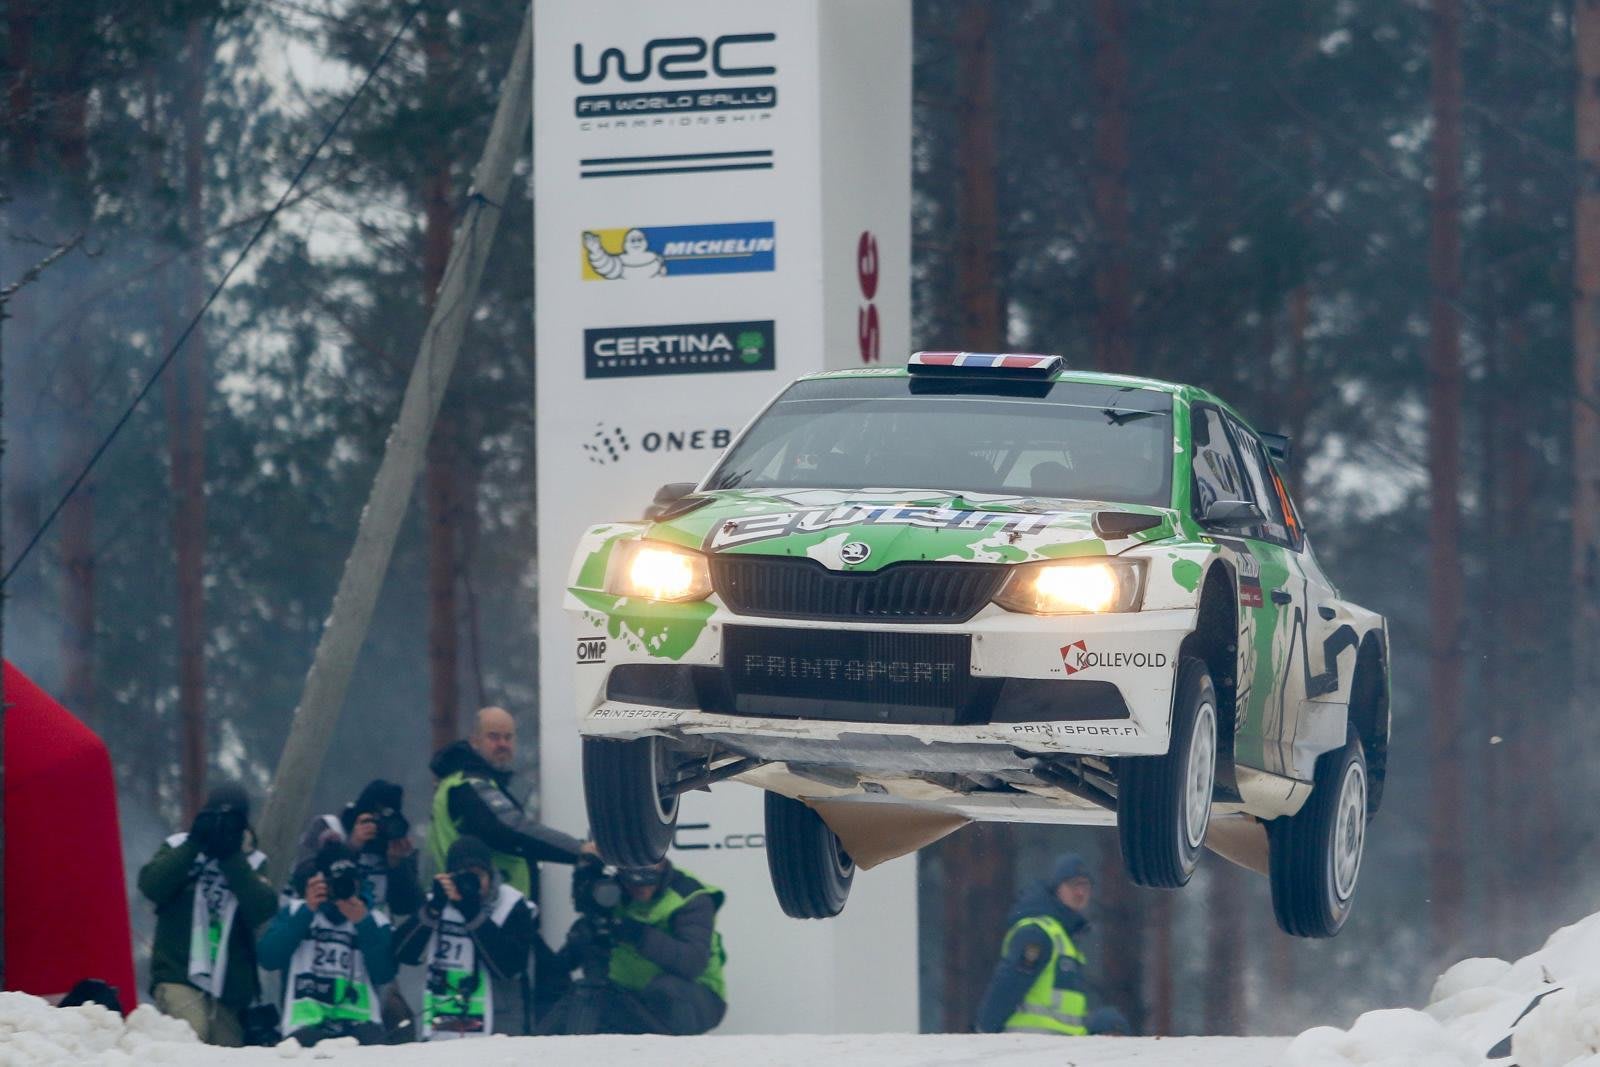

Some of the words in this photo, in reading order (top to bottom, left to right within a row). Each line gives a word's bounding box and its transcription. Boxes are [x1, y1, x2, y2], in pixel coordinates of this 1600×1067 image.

[574, 32, 776, 84] WRC
[578, 100, 611, 112] FIA
[615, 96, 693, 110] WORLD
[697, 92, 773, 106] RALLY
[580, 112, 771, 131] CHAMPIONSHIP
[663, 237, 774, 256] MICHELIN
[594, 333, 733, 357] CERTINA
[642, 429, 731, 453] ONEB
[577, 641, 606, 660] OMP
[1076, 652, 1167, 668] KOLLEVOLD
[745, 655, 955, 683] PRINTSPORT
[593, 709, 680, 720] PRINTSPORT.FI
